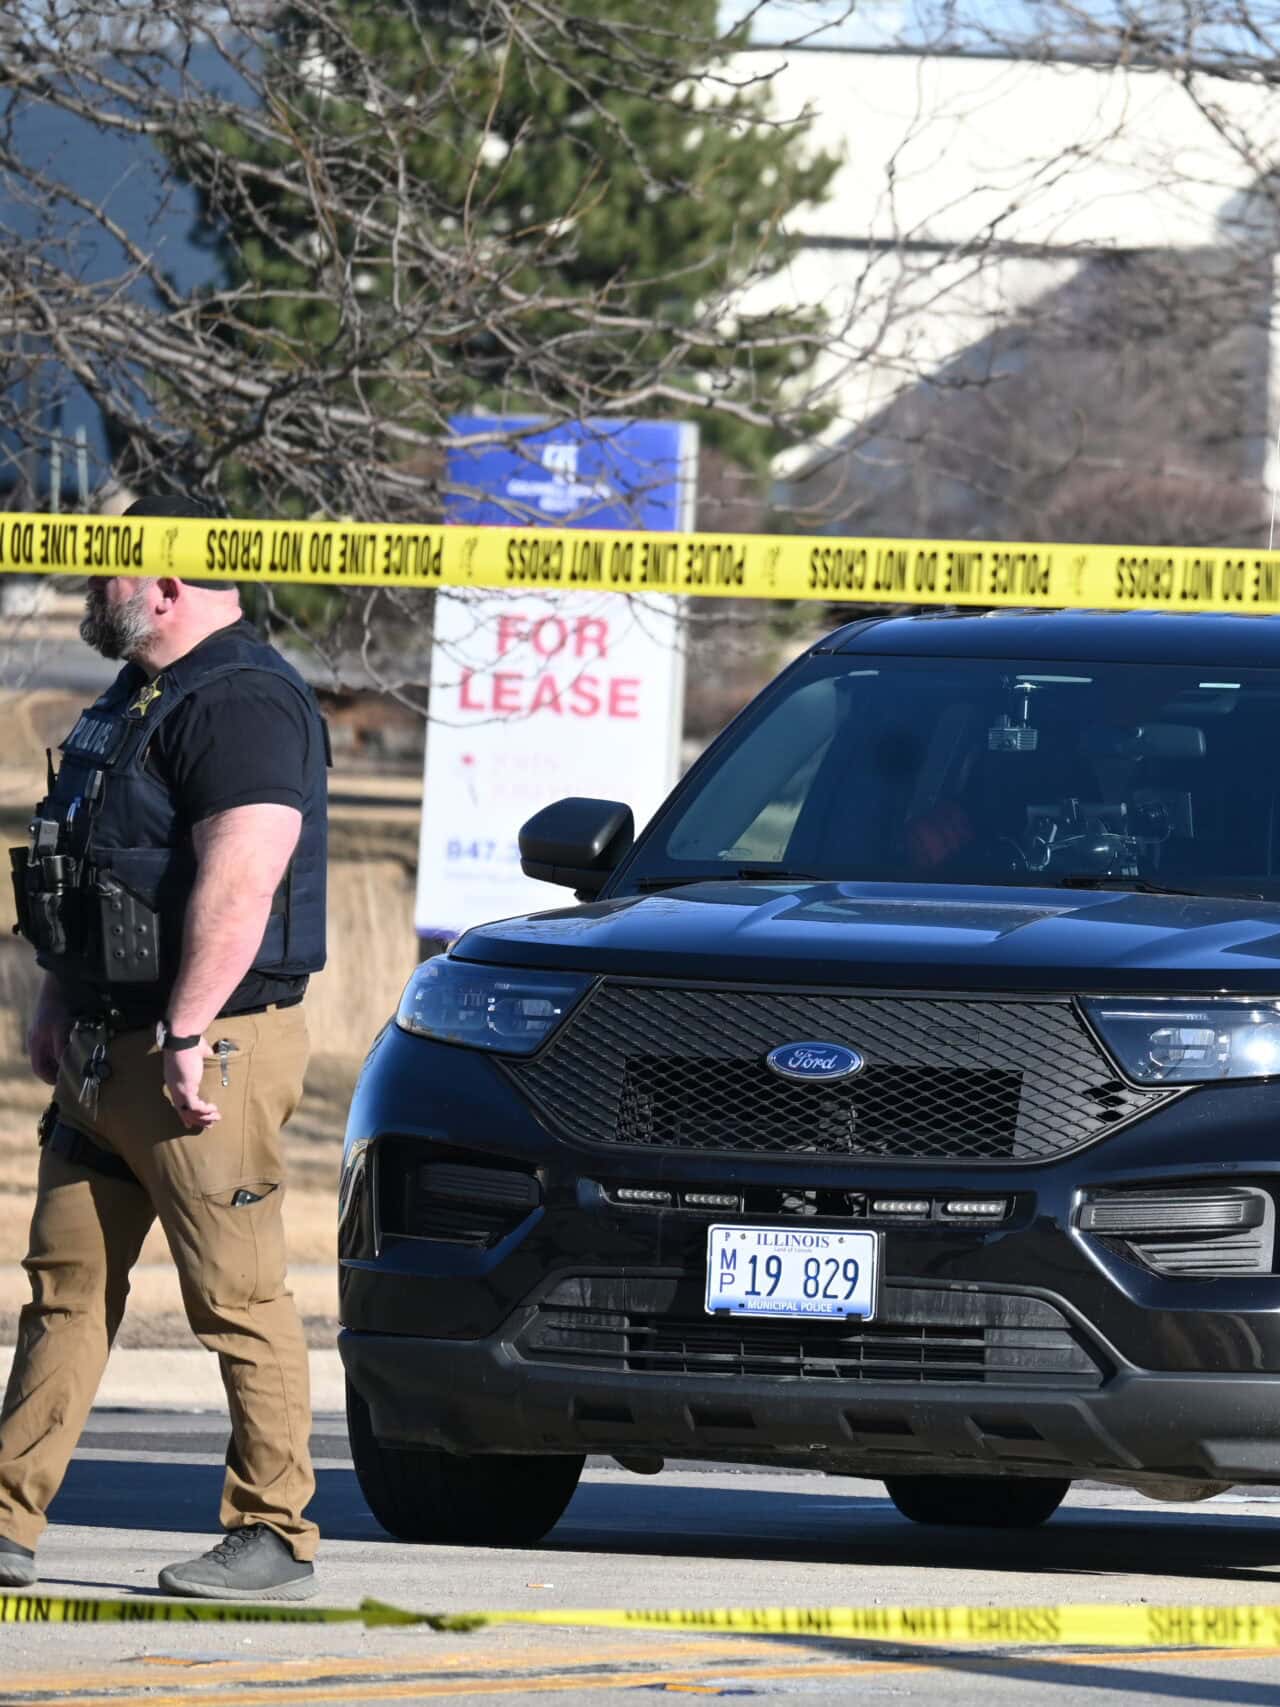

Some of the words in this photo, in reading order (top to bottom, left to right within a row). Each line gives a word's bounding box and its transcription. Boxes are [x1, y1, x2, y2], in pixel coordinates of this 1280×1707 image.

[10, 523, 35, 564] DO
[40, 524, 78, 565] LINE
[84, 526, 145, 567] POLICE
[205, 529, 264, 571] CROSS
[269, 531, 303, 573] NOT
[309, 532, 333, 573] DO
[339, 534, 377, 575] LINE
[382, 535, 444, 576] POLICE
[506, 539, 565, 581] CROSS
[569, 540, 605, 581] NOT
[609, 541, 634, 582] DO
[641, 543, 679, 583] LINE
[685, 544, 747, 586] POLICE
[496, 614, 609, 659] FOR
[458, 667, 640, 719] LEASE
[788, 1048, 838, 1069] Ford
[757, 1233, 830, 1249] ILLINOIS
[745, 1255, 783, 1297] 19
[803, 1257, 860, 1300] 829
[747, 1300, 798, 1312] MUNICIPAL
[800, 1303, 833, 1313] POLICE
